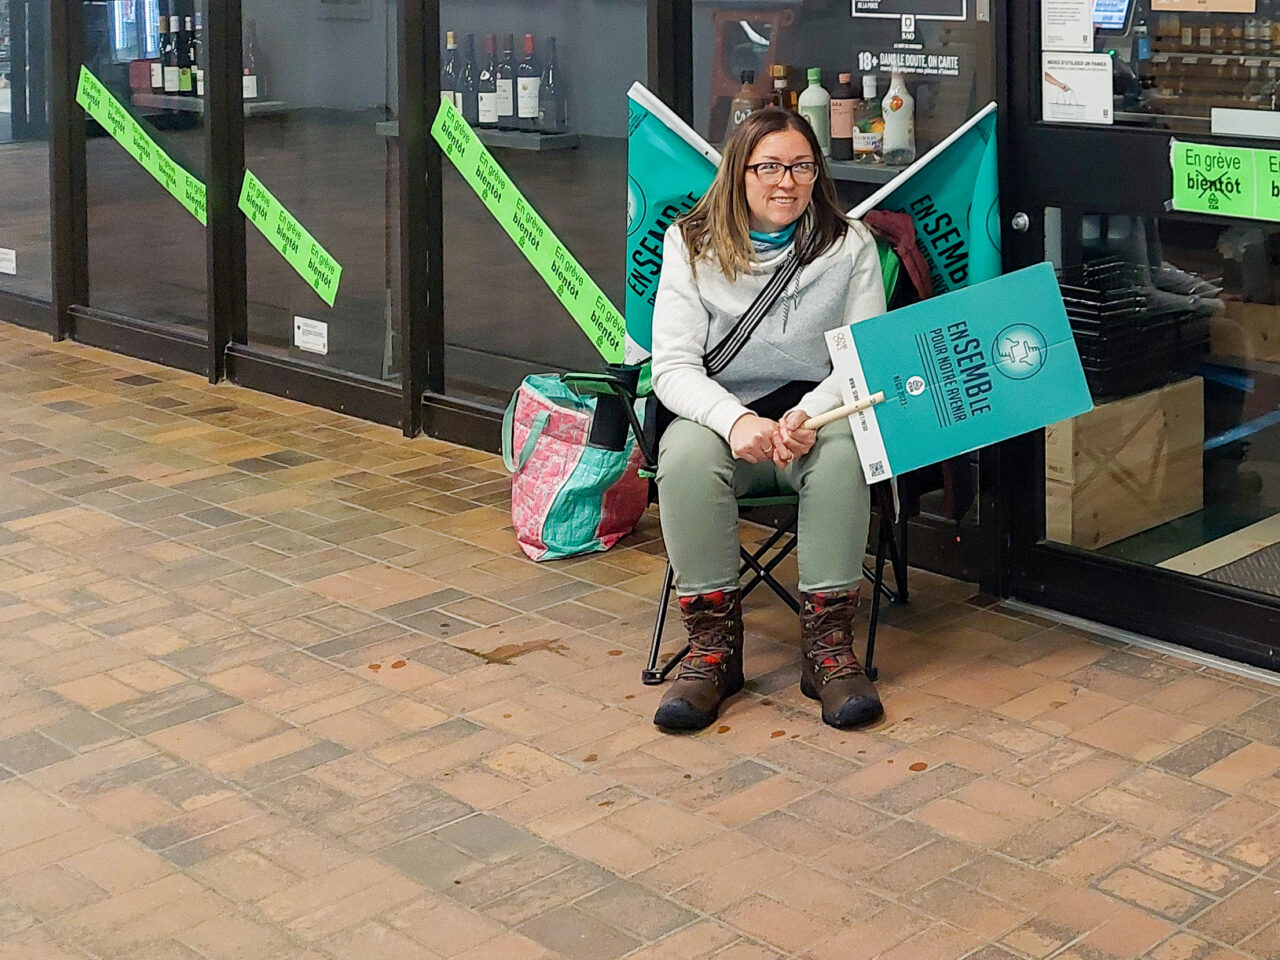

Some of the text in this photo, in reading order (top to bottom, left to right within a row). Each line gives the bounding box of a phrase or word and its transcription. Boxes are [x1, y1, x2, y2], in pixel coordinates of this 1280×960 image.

[901, 32, 915, 40] SAQ
[858, 51, 879, 71] 18+
[880, 52, 897, 65] DANS
[897, 53, 905, 66] LE
[928, 55, 938, 67] ON
[938, 55, 959, 69] CARTE
[441, 121, 466, 158] bientôt
[446, 106, 470, 145] En grève
[479, 151, 506, 190] En grève
[1185, 149, 1241, 172] En grève
[248, 177, 270, 208] En grève
[475, 166, 503, 203] bientôt
[1187, 172, 1242, 194] bientôt
[246, 191, 268, 221] bientôt
[516, 197, 544, 238] En grève
[276, 223, 299, 254] bientôt
[278, 210, 302, 241] En grève
[512, 212, 540, 251] bientôt
[307, 258, 332, 289] bientôt
[310, 243, 335, 276] En grève
[554, 245, 584, 287] En grève
[551, 259, 580, 300] bientôt
[590, 309, 620, 352] bientôt
[595, 295, 626, 338] En grève
[929, 328, 968, 423] POUR NOTRE AVENIR
[946, 320, 993, 417] ENSEMBLE
